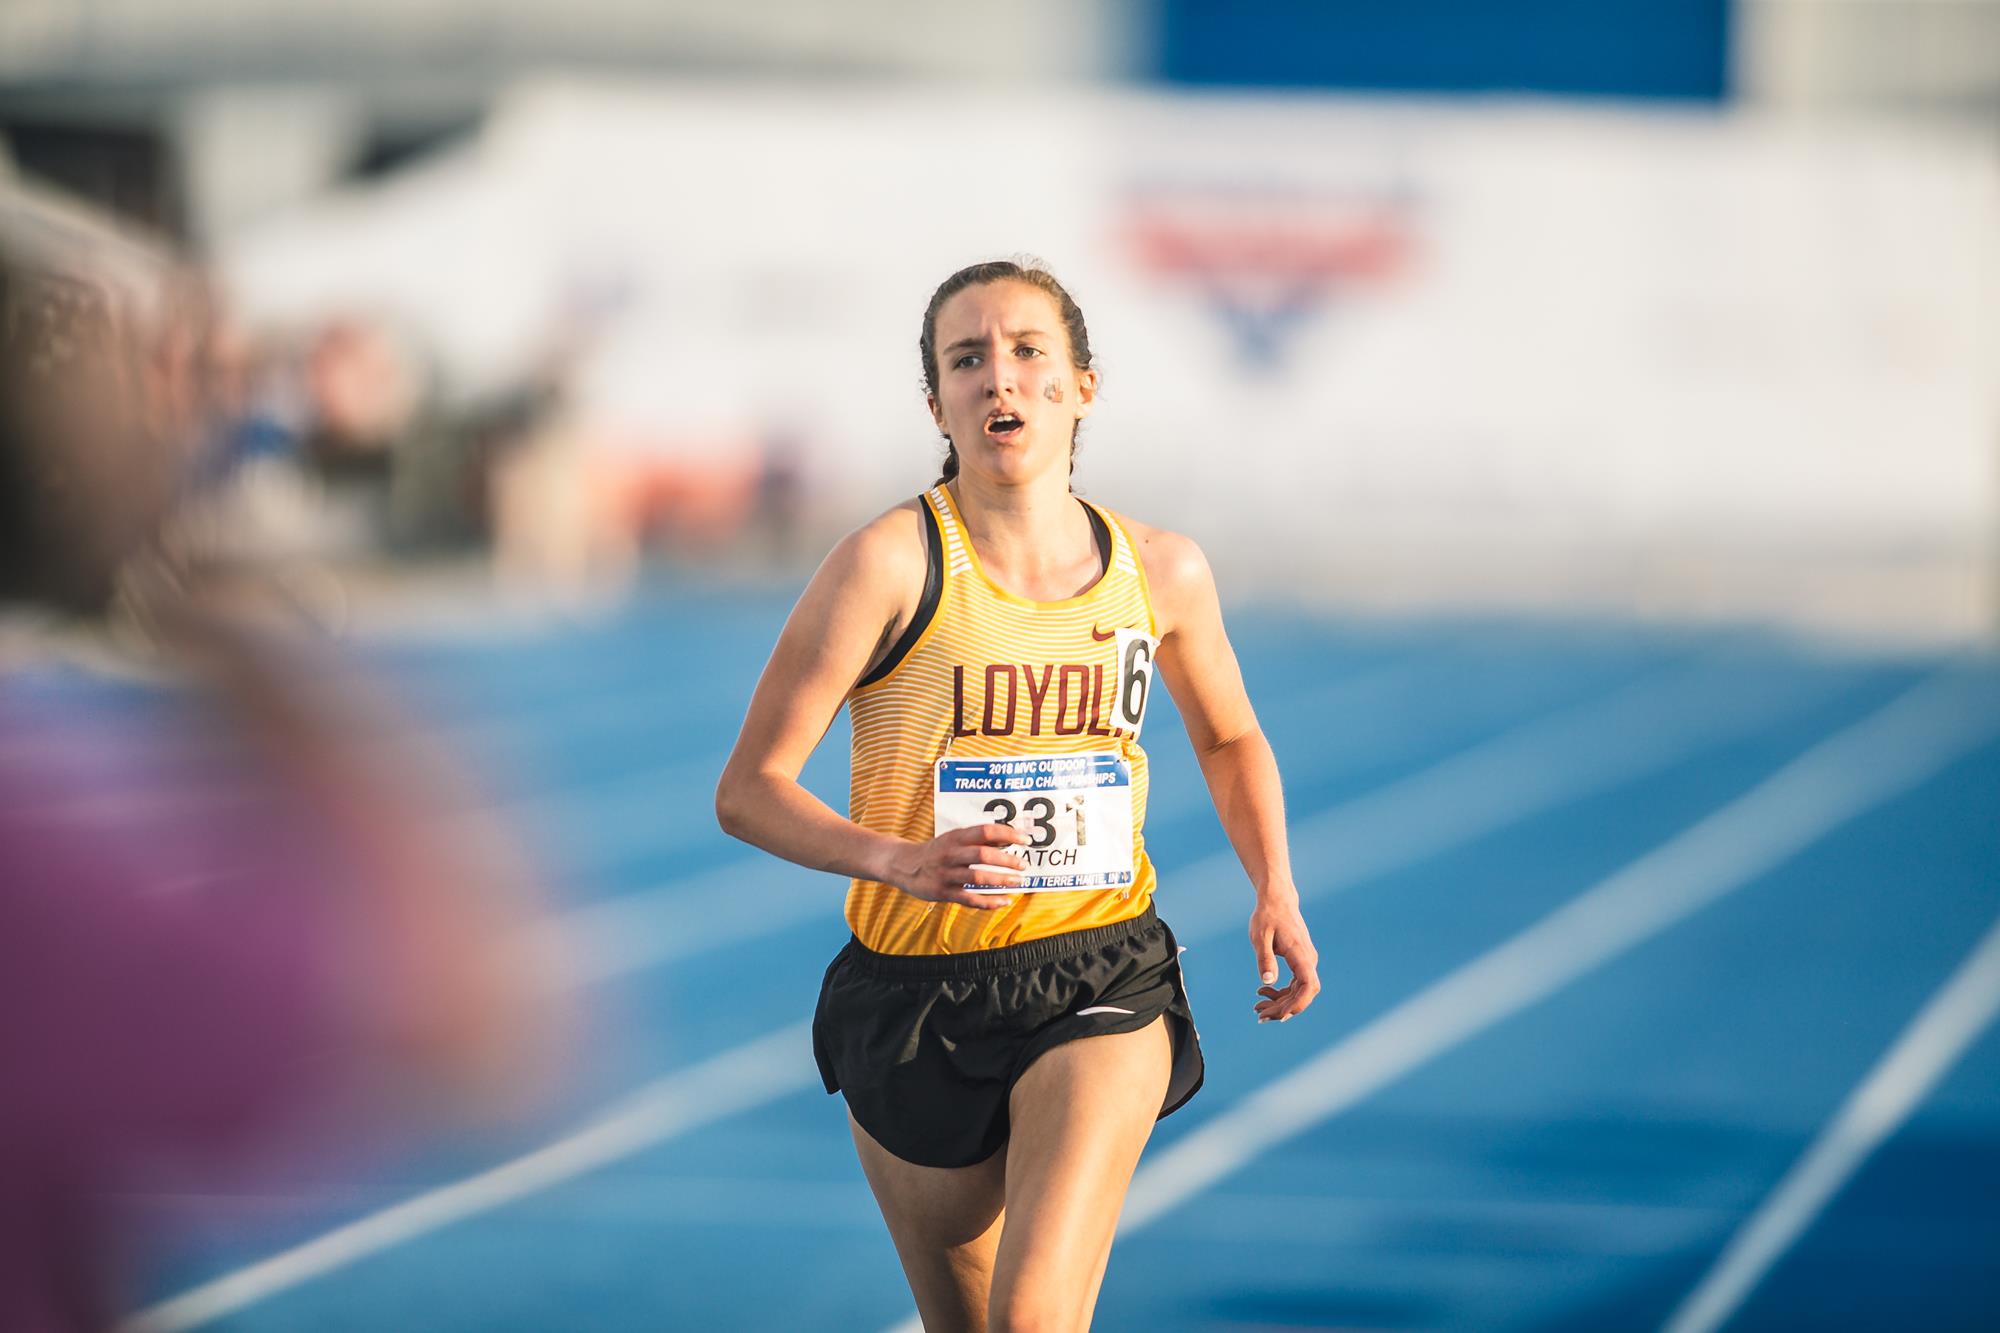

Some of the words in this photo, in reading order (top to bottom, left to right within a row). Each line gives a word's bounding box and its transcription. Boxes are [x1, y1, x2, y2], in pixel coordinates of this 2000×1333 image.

[1122, 638, 1150, 725] 6
[953, 664, 1134, 739] LOYOL
[989, 764, 1013, 775] 2018
[1015, 762, 1037, 774] MVC
[1038, 759, 1086, 772] OUTDOOR
[955, 778, 992, 790] TRACK
[994, 779, 1002, 789] &
[1004, 778, 1034, 790] FIELD
[1005, 848, 1078, 867] ATCH
[1041, 875, 1075, 887] TERRE
